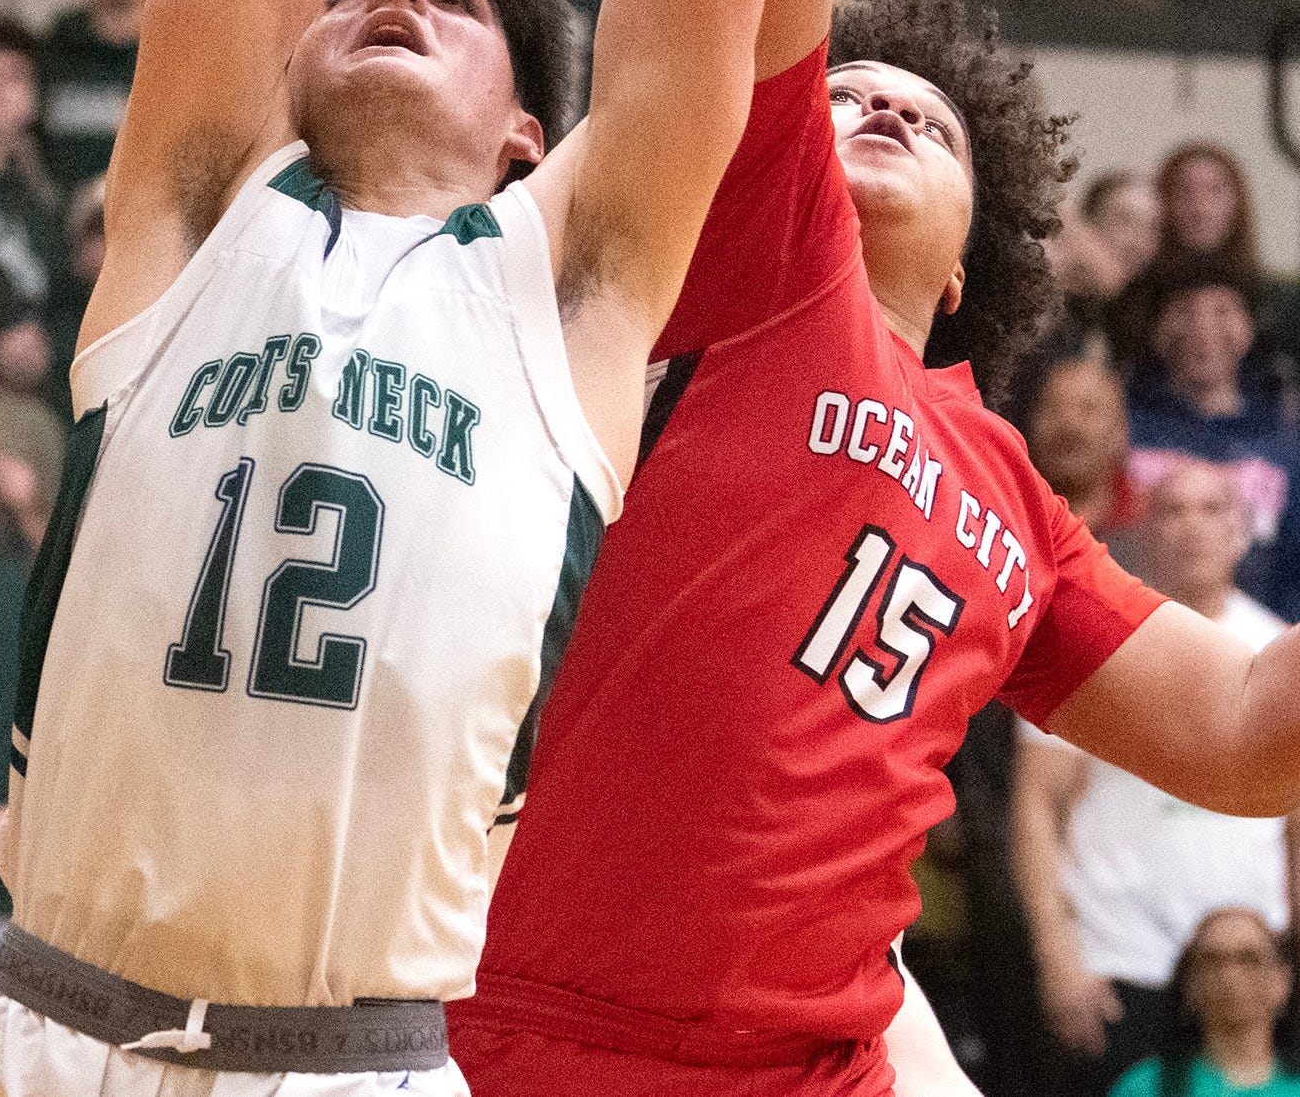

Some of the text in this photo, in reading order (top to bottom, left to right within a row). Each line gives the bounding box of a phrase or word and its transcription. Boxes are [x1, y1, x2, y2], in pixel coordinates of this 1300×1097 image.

[333, 347, 481, 487] NECK
[807, 390, 945, 522] OCEAN
[162, 456, 386, 710] 12
[791, 523, 966, 725] 15
